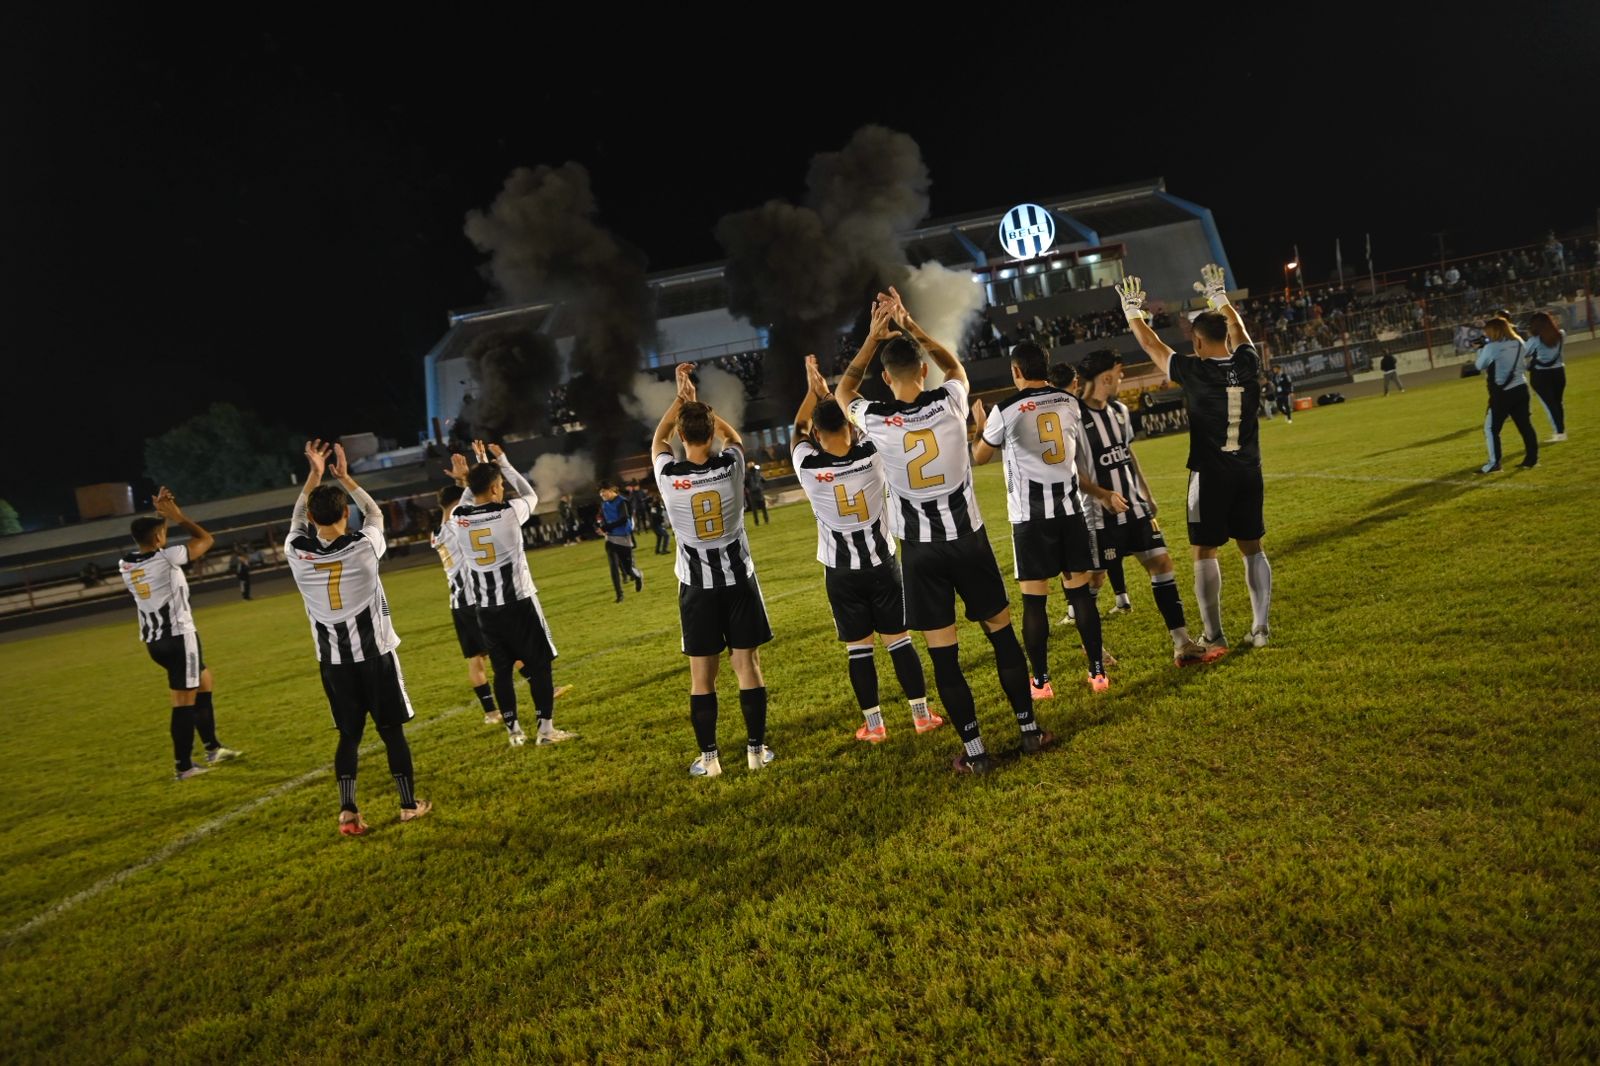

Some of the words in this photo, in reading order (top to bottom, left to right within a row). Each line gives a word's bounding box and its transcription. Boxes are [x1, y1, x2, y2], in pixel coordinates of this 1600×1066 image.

[903, 428, 945, 489] 2
[1036, 411, 1066, 465] 9
[690, 489, 725, 541] 8
[833, 483, 870, 523] 4
[468, 528, 497, 567] 5
[313, 560, 344, 611] 7
